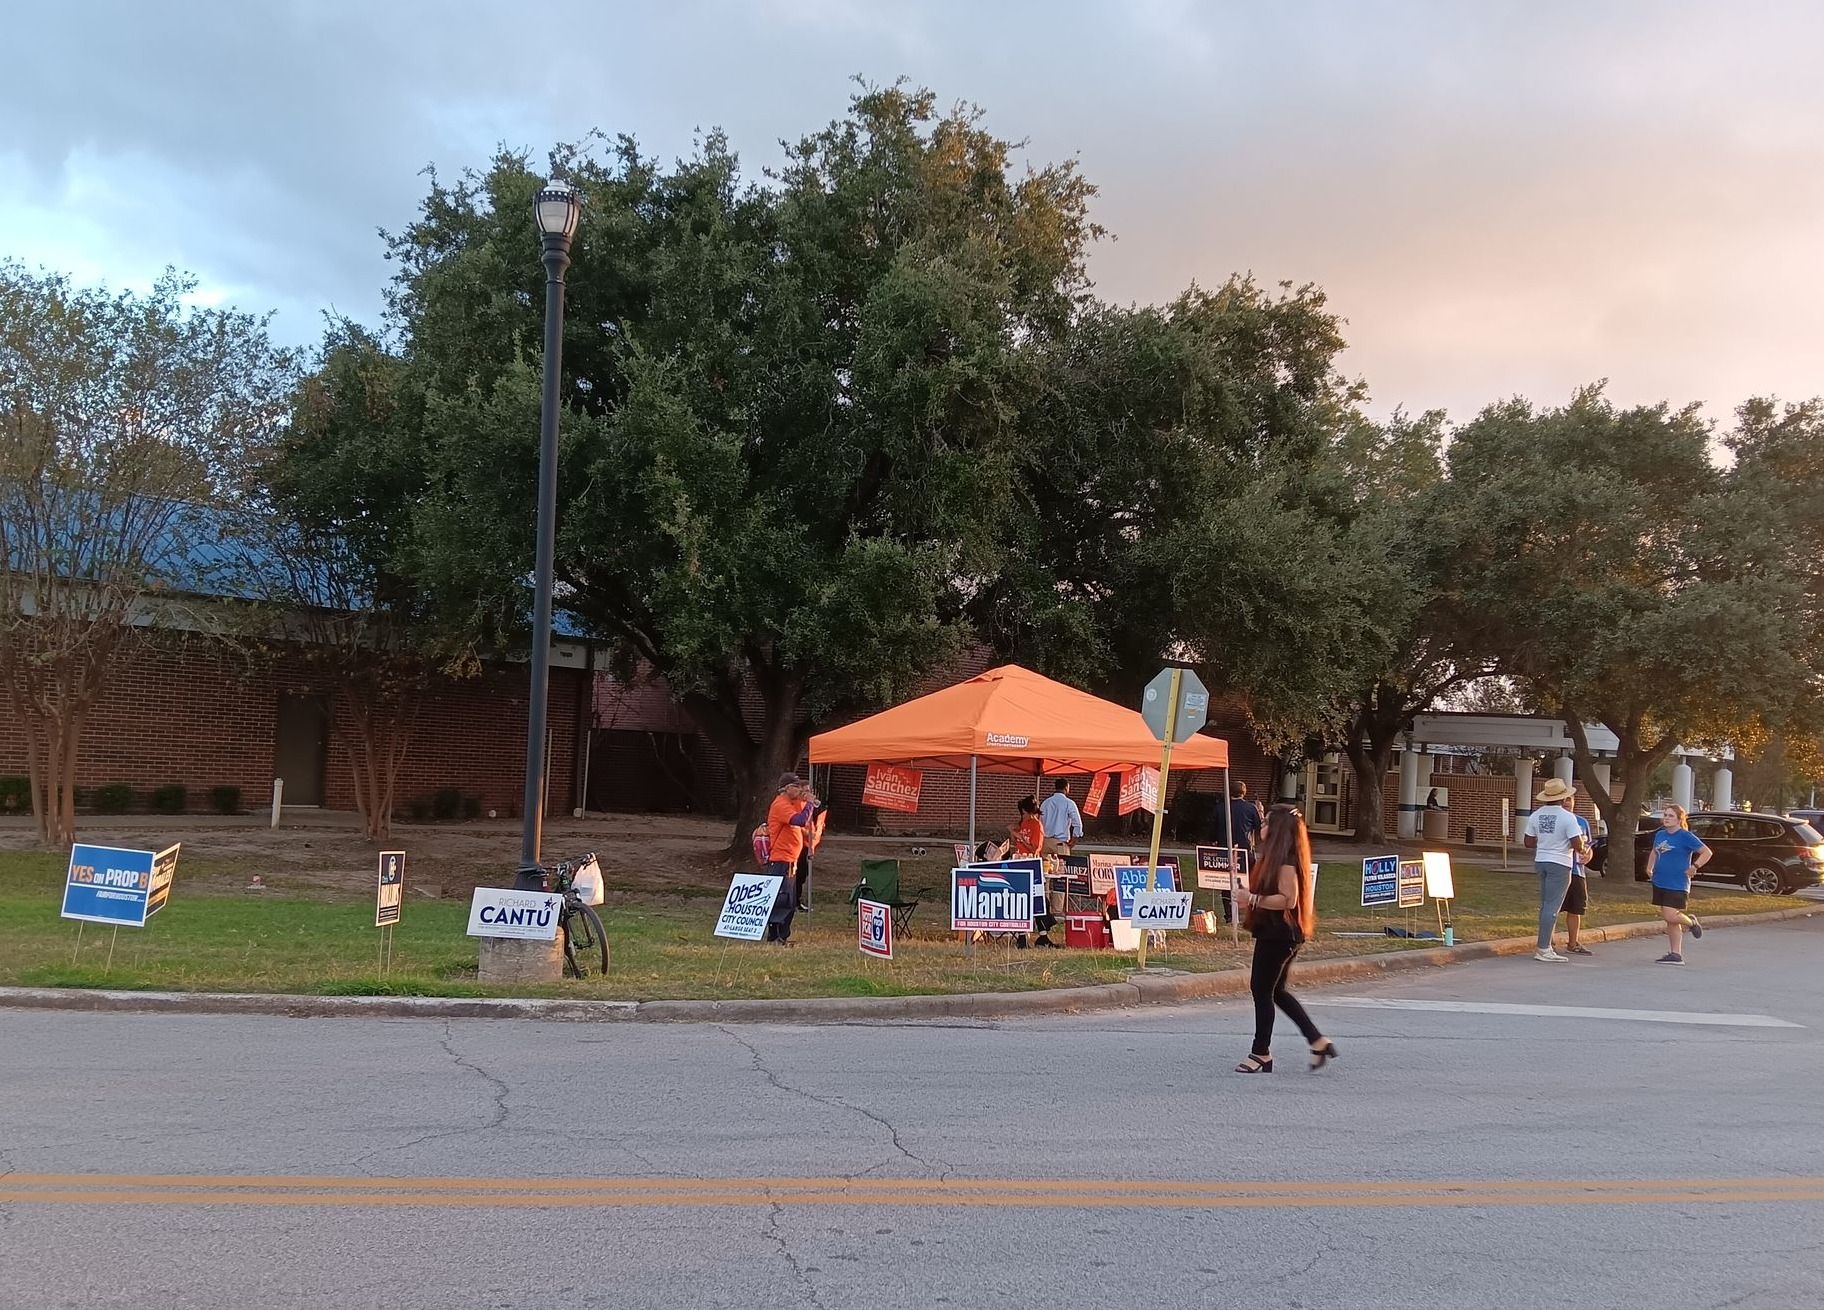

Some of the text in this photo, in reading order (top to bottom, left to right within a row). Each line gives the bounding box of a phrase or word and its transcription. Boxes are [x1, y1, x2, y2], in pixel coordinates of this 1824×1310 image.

[986, 732, 1029, 748] Academy
[866, 775, 918, 796] Sanchez
[1120, 779, 1159, 798] Sanche
[71, 864, 94, 884] YES
[94, 872, 105, 884] ON
[105, 868, 138, 888] PROP
[138, 872, 149, 889] B
[728, 881, 765, 905] Obes
[1365, 882, 1394, 893] HOUSTON
[498, 898, 537, 909] RICHARD
[729, 903, 770, 917] HOUSTON
[957, 885, 1029, 920] Martin
[721, 914, 764, 927] CITY COUNCIL
[988, 921, 1000, 929] CITY
